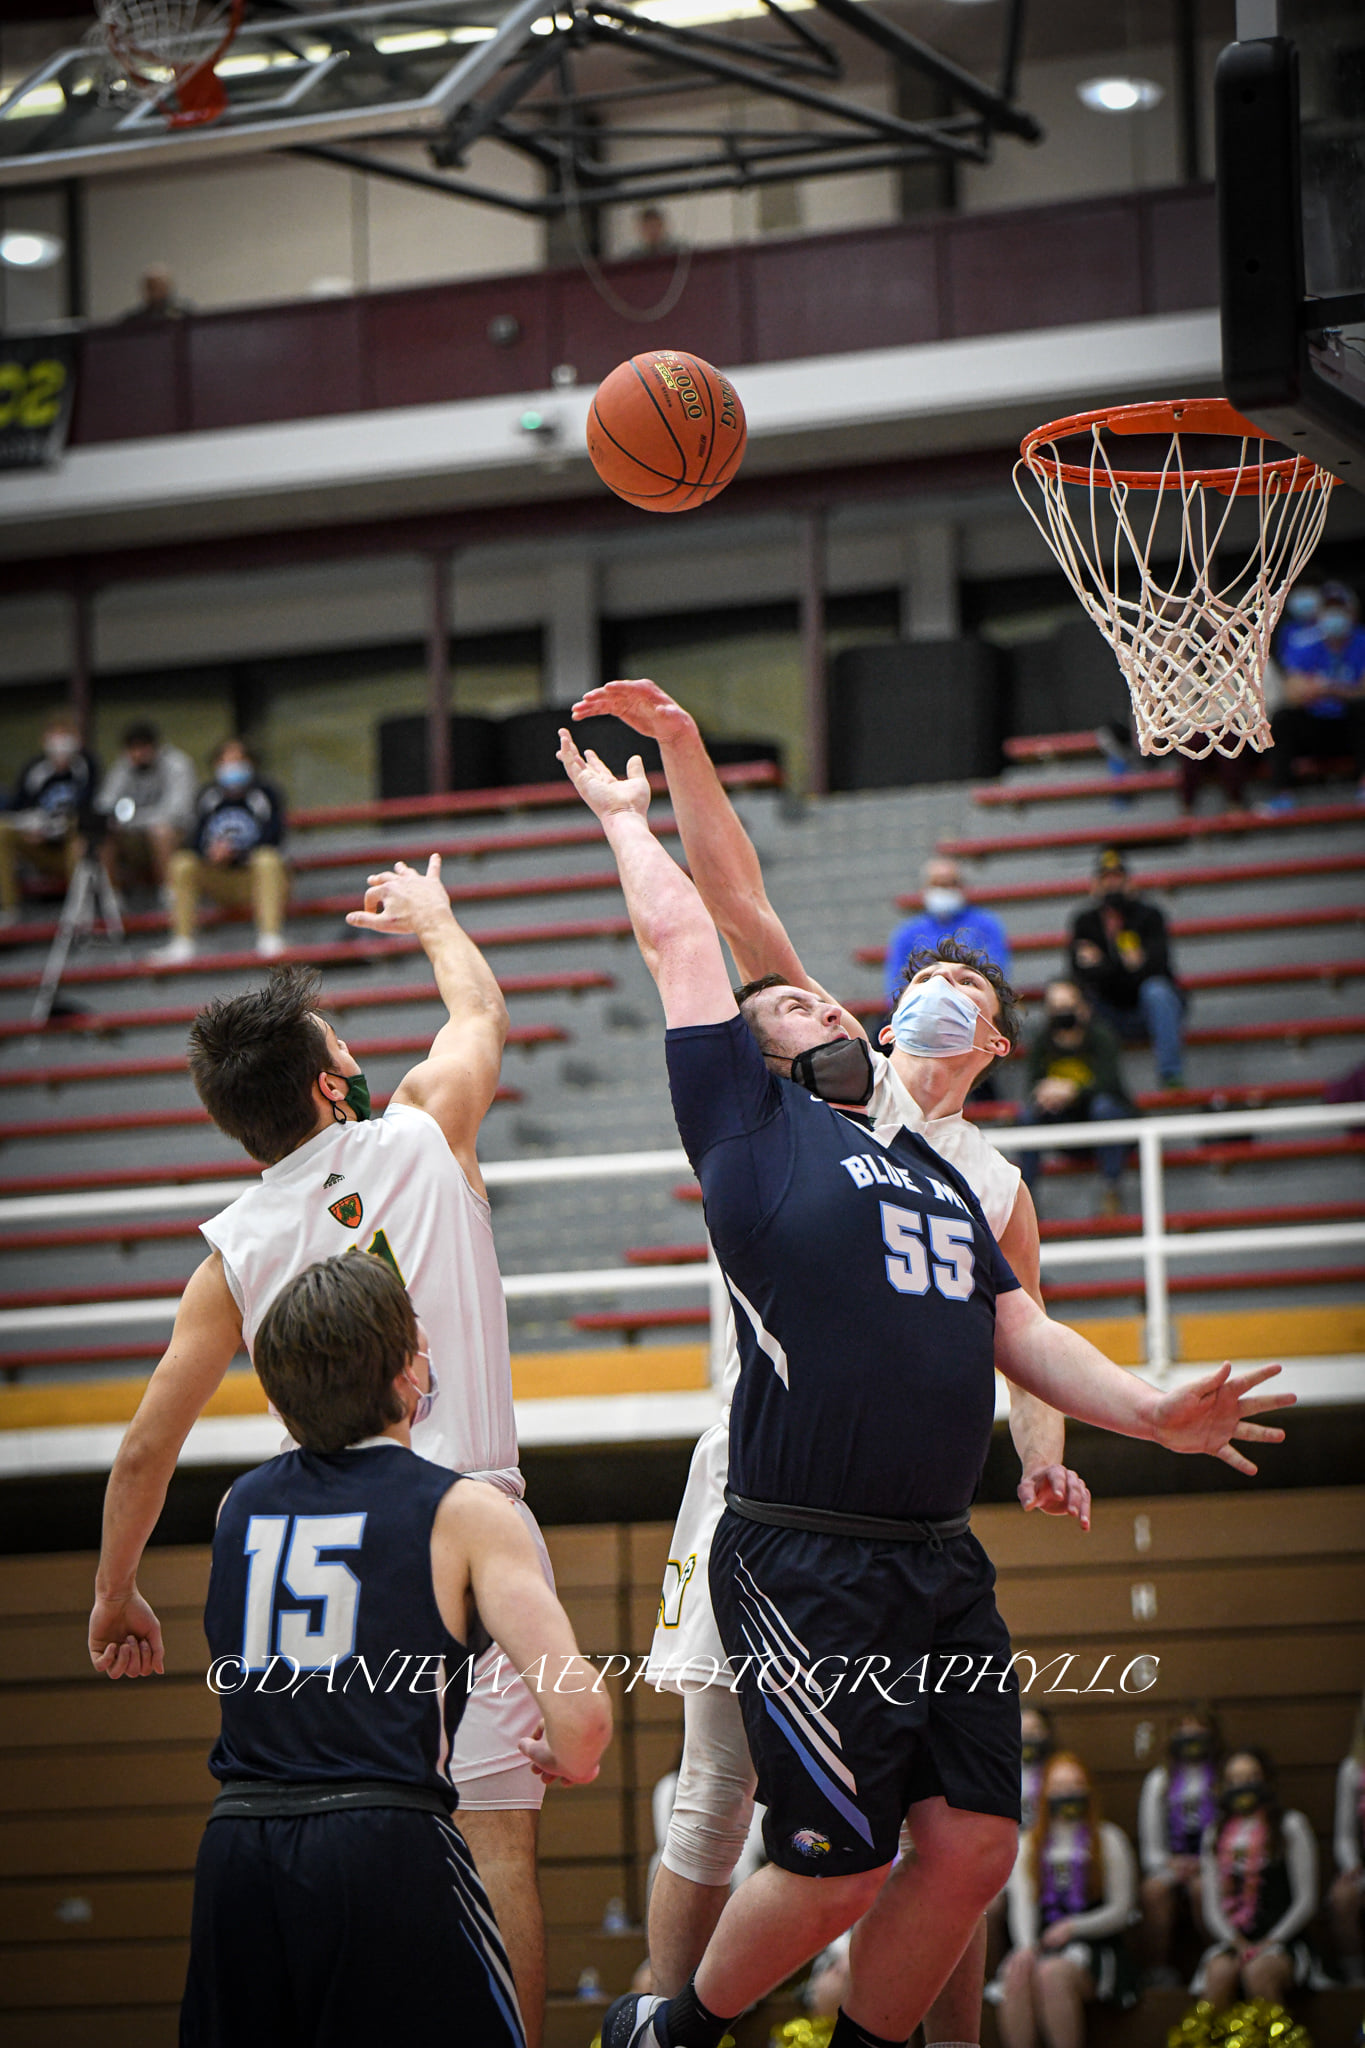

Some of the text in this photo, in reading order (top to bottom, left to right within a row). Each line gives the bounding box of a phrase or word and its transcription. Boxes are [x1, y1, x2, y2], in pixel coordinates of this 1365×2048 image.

[840, 1154, 923, 1190] BLUE
[879, 1200, 976, 1302] 55
[240, 1511, 368, 1673] 15
